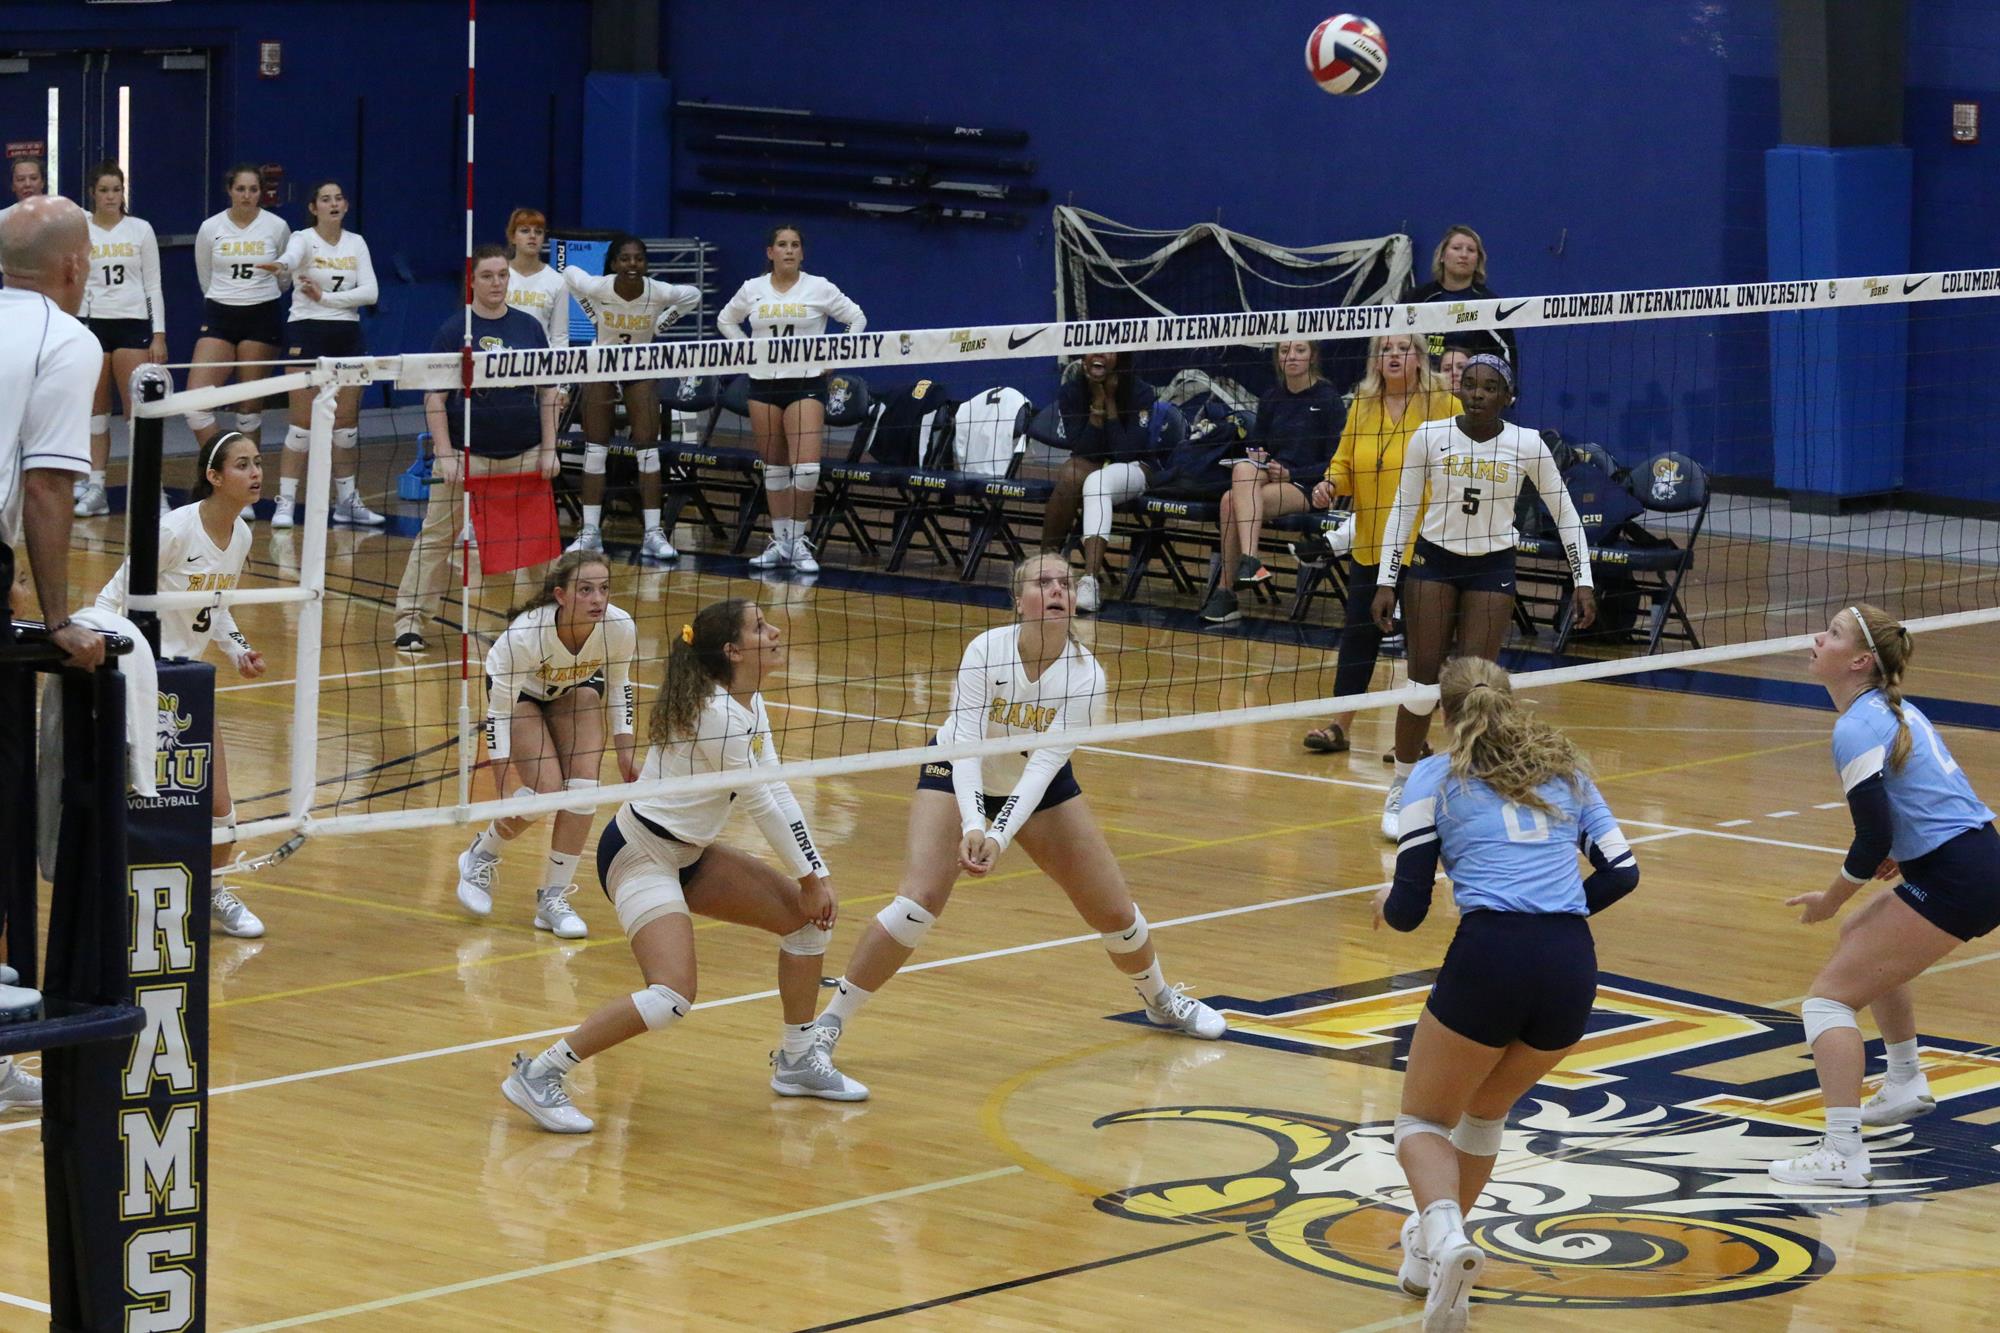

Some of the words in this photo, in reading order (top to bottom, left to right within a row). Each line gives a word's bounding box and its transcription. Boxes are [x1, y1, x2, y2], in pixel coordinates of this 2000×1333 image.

[221, 241, 265, 256] RAMS
[102, 264, 125, 286] 13
[331, 276, 344, 292] 7
[1941, 270, 2000, 293] COLUMBIA
[506, 290, 545, 308] AMS
[1543, 294, 1613, 319] COLUMBIA
[1619, 287, 1730, 314] INTERNATIONAL
[1737, 282, 1818, 307] UNIVERSITY
[603, 311, 651, 330] RAMS
[759, 304, 807, 319] RAMS
[1456, 310, 1478, 324] HORNS
[1063, 320, 1149, 347] COLUMBIA
[1156, 312, 1289, 342] INTERNATIONAL
[1296, 306, 1394, 333] UNIVERSITY
[960, 337, 987, 353] HORNS
[485, 350, 588, 379] COLUMBIA
[597, 340, 758, 373] INTERNATIONAL
[767, 334, 884, 364] UNIVERSITY
[678, 451, 692, 463] CIU
[694, 453, 717, 465] RAMS
[847, 469, 871, 481] RAMS
[1442, 454, 1511, 484] RAMS
[908, 475, 923, 487] CIU
[924, 476, 946, 489] RAMS
[985, 483, 1001, 495] CIU
[1002, 484, 1026, 497] RAMS
[1147, 501, 1161, 513] CIU
[1164, 502, 1188, 515] RAMS
[1461, 487, 1482, 516] 5
[1582, 513, 1603, 524] CIU
[1388, 550, 1402, 580] LOCK
[1602, 551, 1629, 564] RAMS
[186, 573, 237, 592] RAMS
[191, 606, 212, 633] 9
[988, 697, 1057, 732] RAMS
[486, 715, 497, 750] LOCK
[127, 795, 200, 810] VOLLEYBALL
[974, 790, 987, 817] OCK
[993, 795, 1020, 833] HORNS
[790, 820, 822, 871] HORNS
[119, 861, 200, 1333] RAMS
